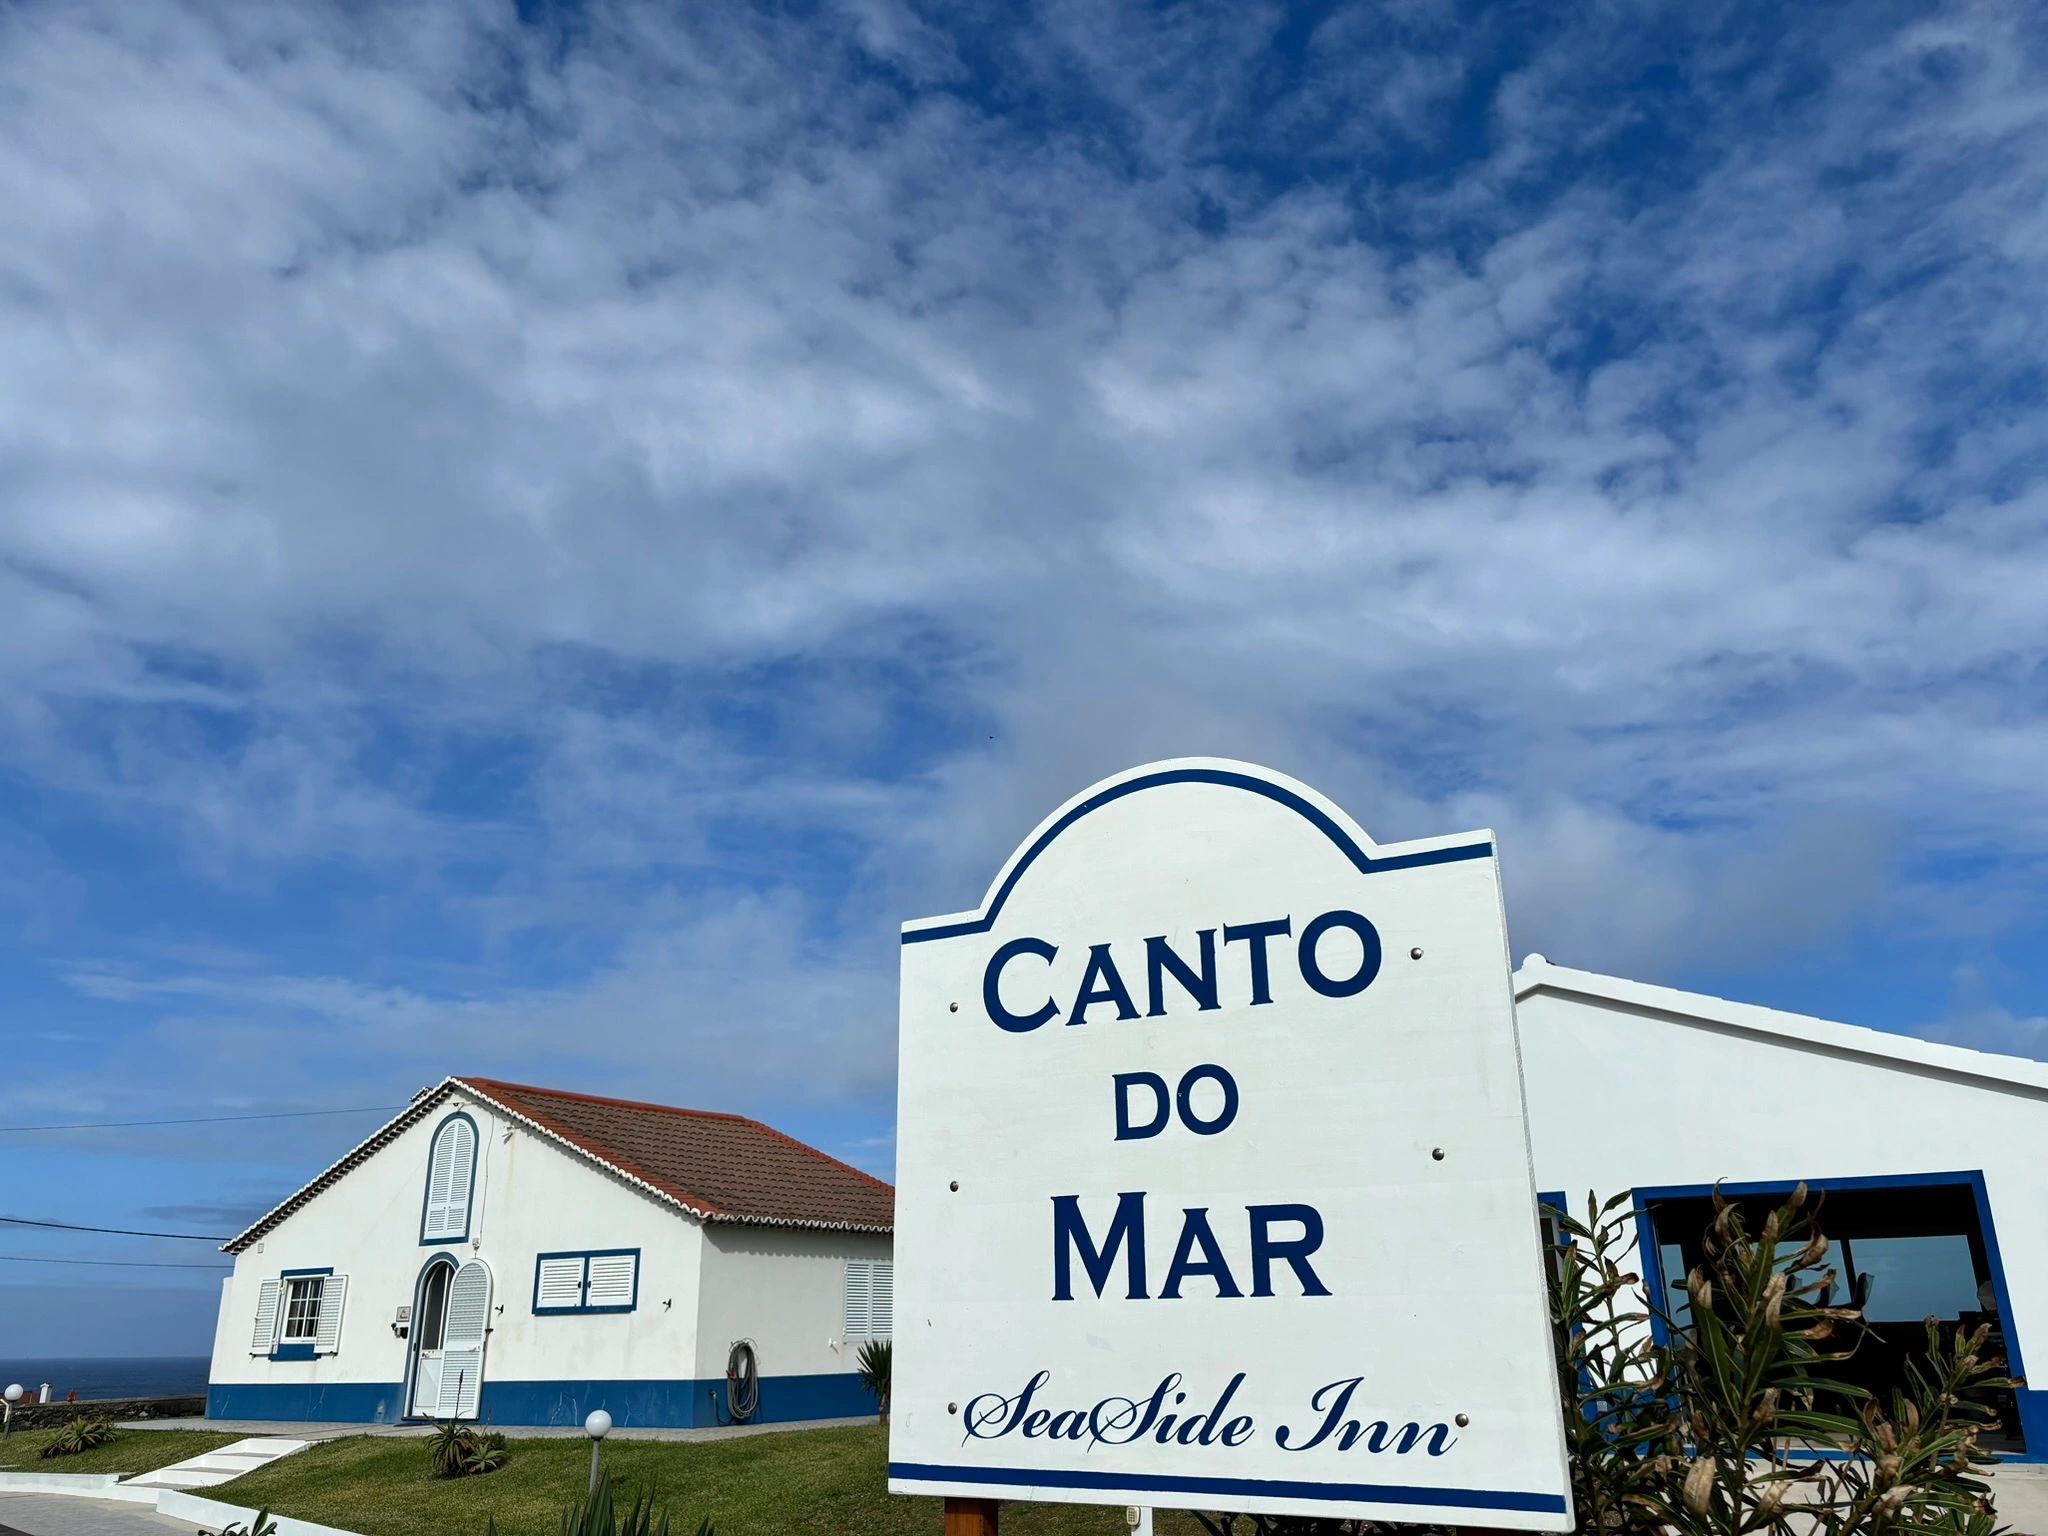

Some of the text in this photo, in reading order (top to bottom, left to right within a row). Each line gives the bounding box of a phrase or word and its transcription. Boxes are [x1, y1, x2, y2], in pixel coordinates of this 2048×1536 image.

[983, 910, 1382, 1033] CANTO
[1112, 1063, 1239, 1141] DO
[1050, 1191, 1333, 1301] MAR
[1275, 1376, 1458, 1457] Inn
